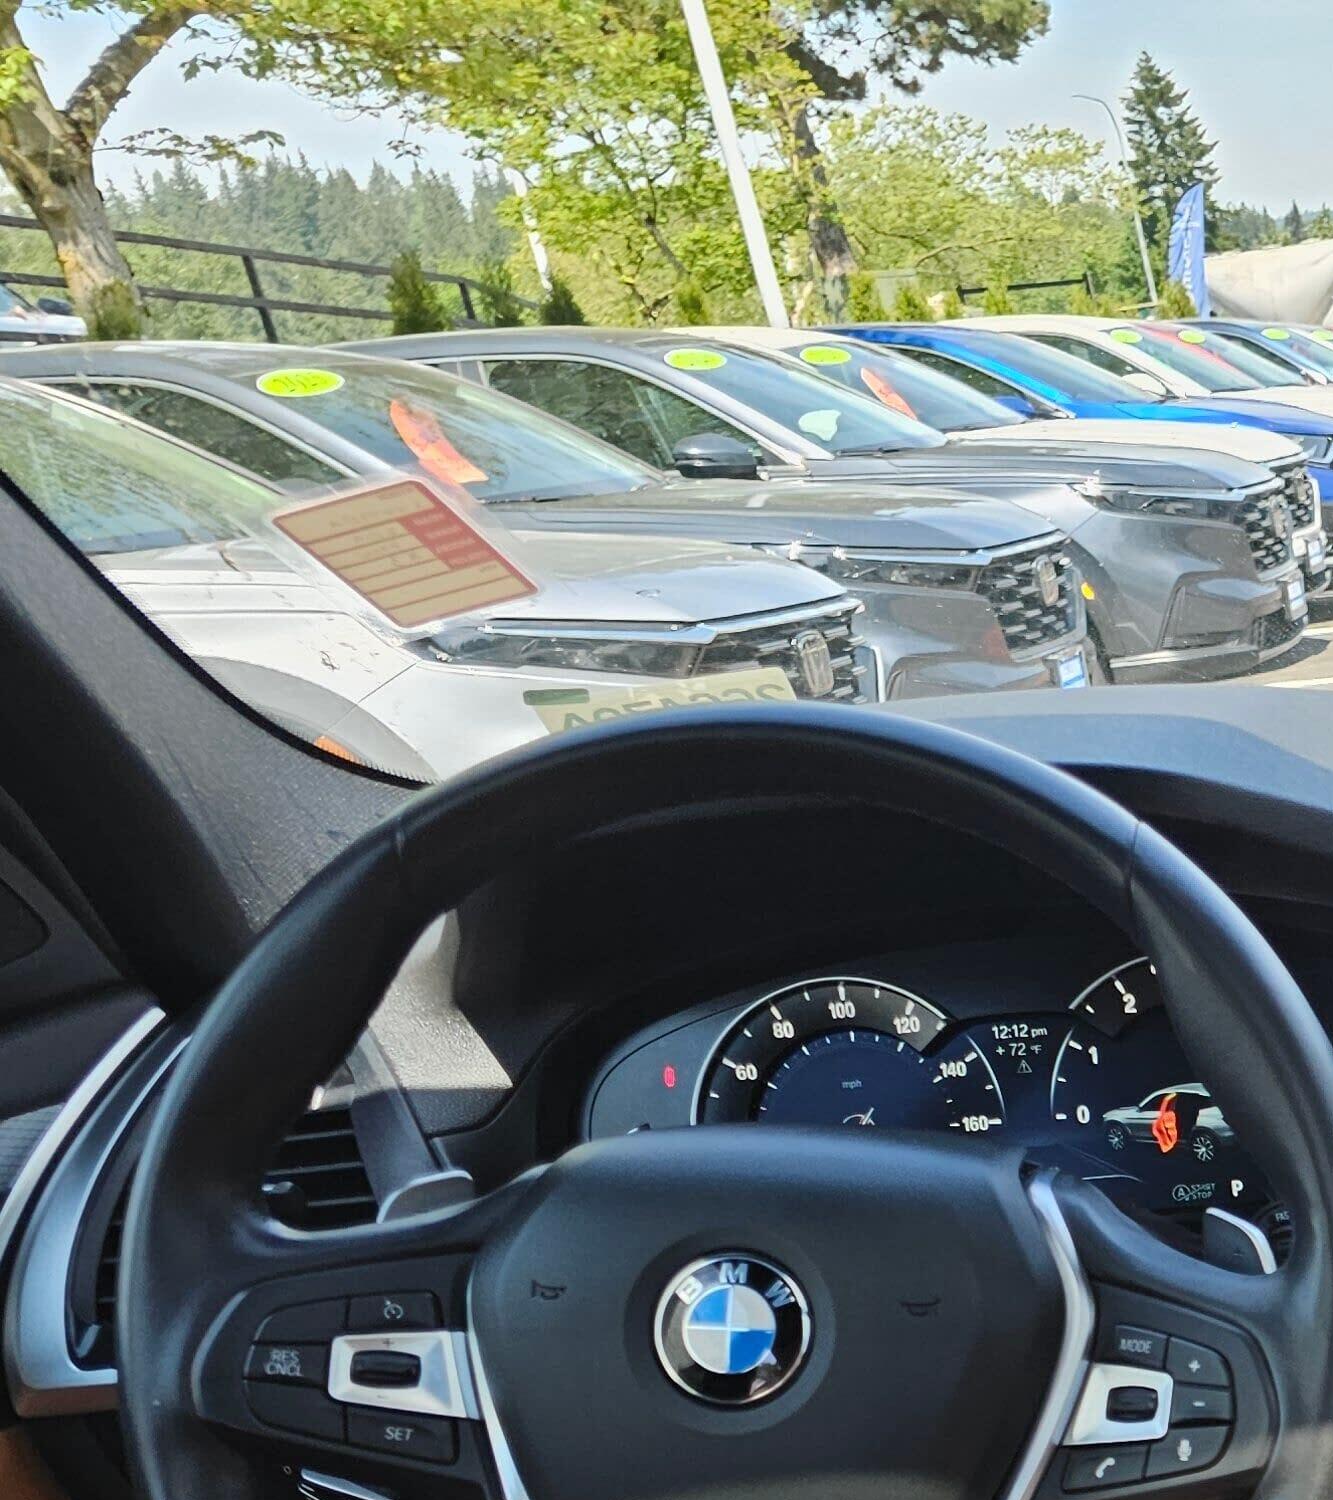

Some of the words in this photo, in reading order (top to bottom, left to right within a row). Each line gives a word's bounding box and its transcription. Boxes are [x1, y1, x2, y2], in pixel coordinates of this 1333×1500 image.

[828, 1001, 856, 1019] 100
[1122, 993, 1138, 1013] 2
[772, 1020, 795, 1040] 80
[893, 1016, 920, 1035] 120
[992, 1024, 1029, 1039] 12:12
[1031, 1027, 1048, 1038] pm
[1009, 1043, 1026, 1056] 72
[1088, 1046, 1098, 1065] 1
[735, 1063, 757, 1081] 60
[940, 1061, 967, 1078] 140
[842, 1080, 862, 1091] mph
[1076, 1105, 1090, 1123] 0
[962, 1115, 988, 1132] 160
[1231, 1179, 1244, 1197] P
[675, 1262, 796, 1308] BMW
[1119, 1338, 1153, 1355] MODE
[270, 1350, 300, 1363] RES
[384, 1426, 414, 1441] SET
